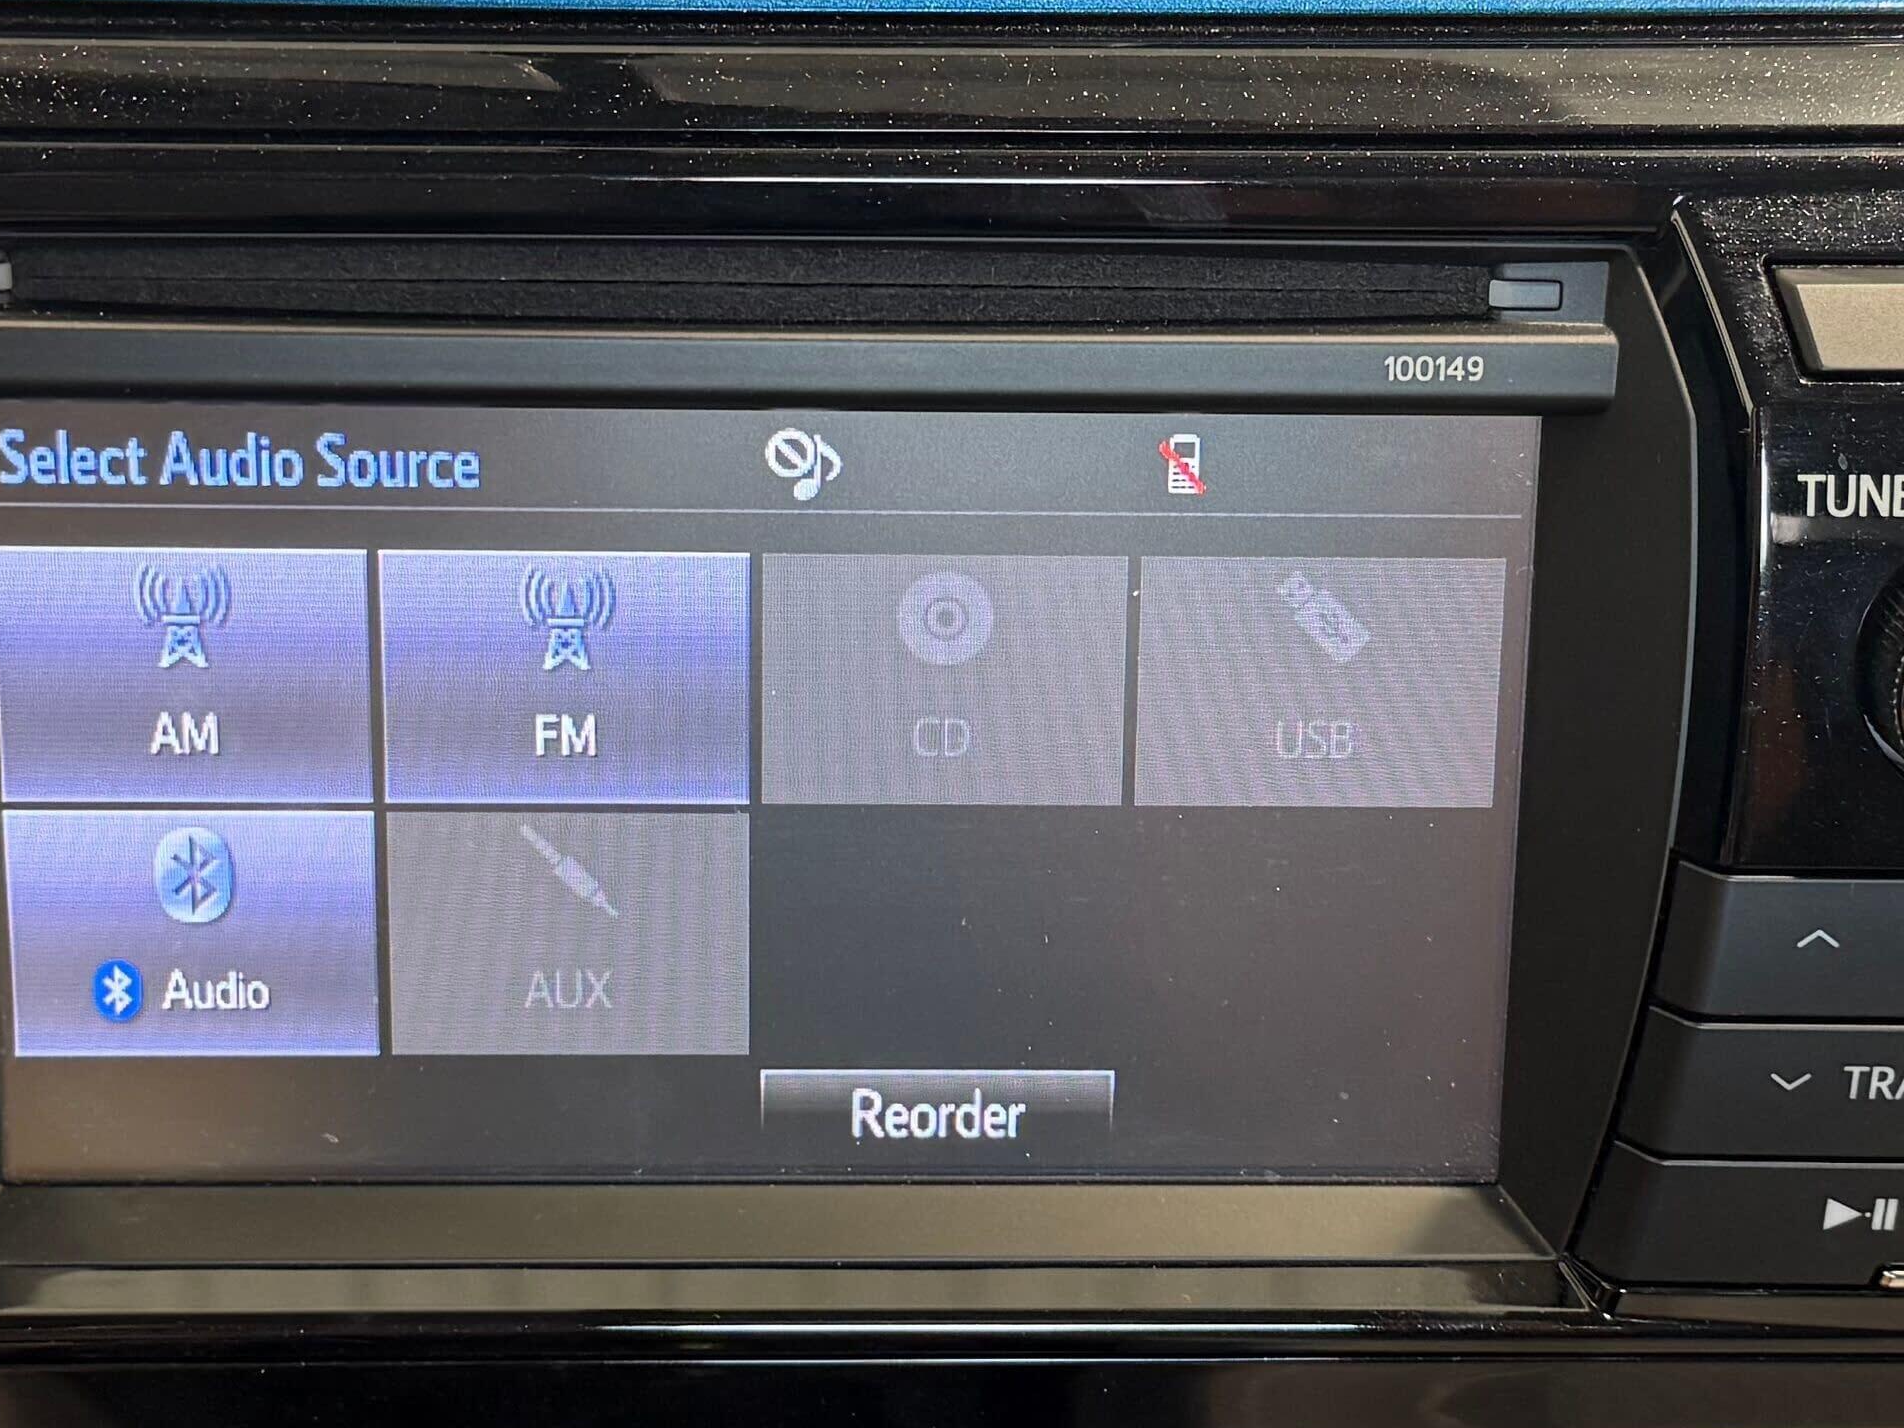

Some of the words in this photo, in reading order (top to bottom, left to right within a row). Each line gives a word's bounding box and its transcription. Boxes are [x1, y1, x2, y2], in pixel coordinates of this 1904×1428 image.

[1384, 356, 1486, 384] 100149
[160, 431, 304, 489] Audio
[314, 432, 481, 490] Source
[149, 712, 220, 757] AM
[534, 714, 598, 759] FM
[913, 717, 971, 759] CD
[1276, 719, 1354, 760] USB
[162, 970, 271, 1012] Audio
[523, 971, 614, 1010] AUX
[850, 1088, 1027, 1139] Reorder
